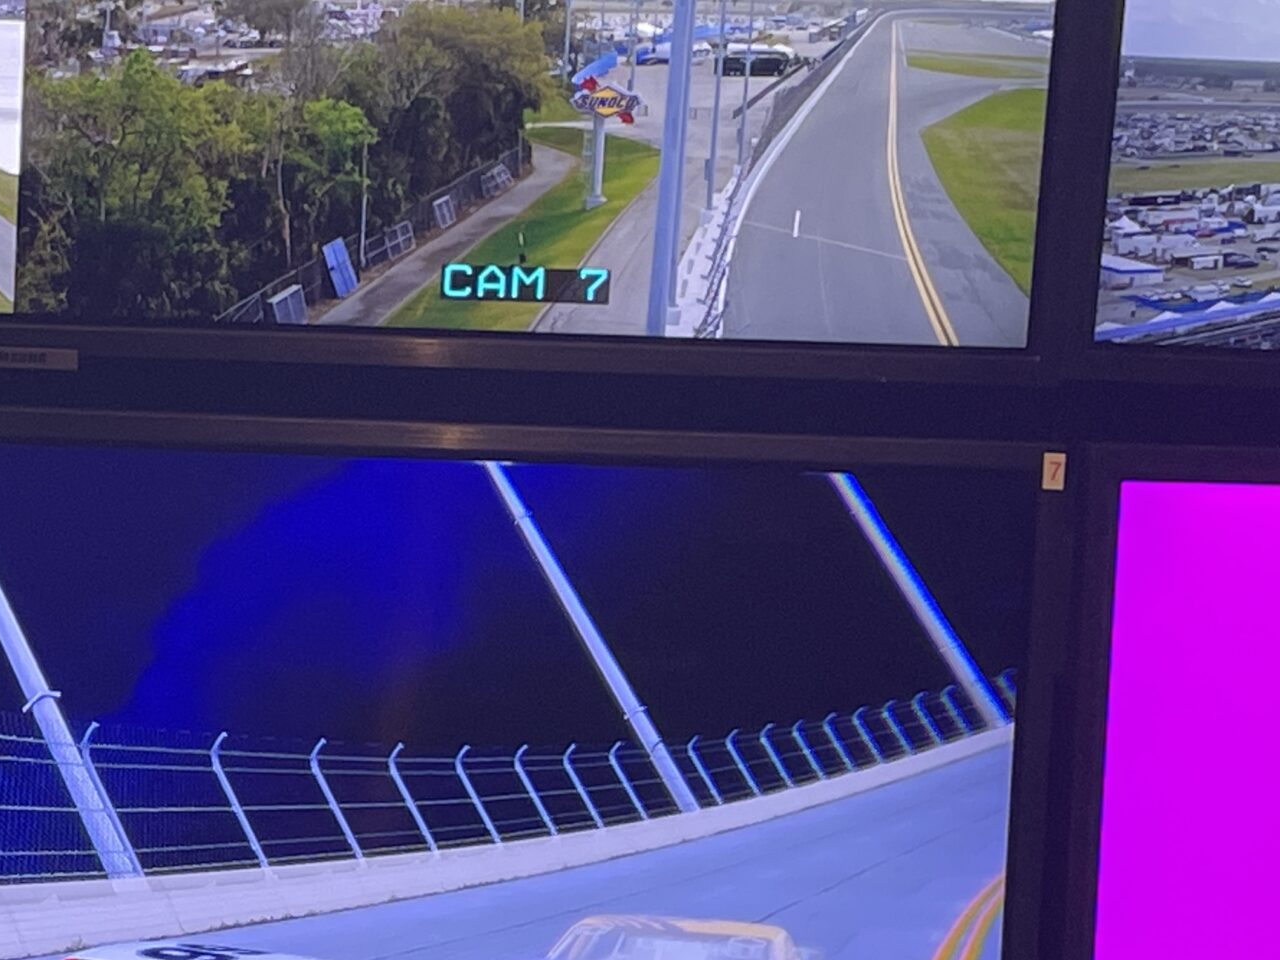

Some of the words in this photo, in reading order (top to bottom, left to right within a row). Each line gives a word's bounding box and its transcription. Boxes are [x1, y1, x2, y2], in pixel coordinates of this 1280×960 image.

[581, 95, 639, 110] SUNOCO
[443, 263, 545, 300] CAM
[580, 268, 608, 301] 7
[1048, 460, 1062, 481] 7
